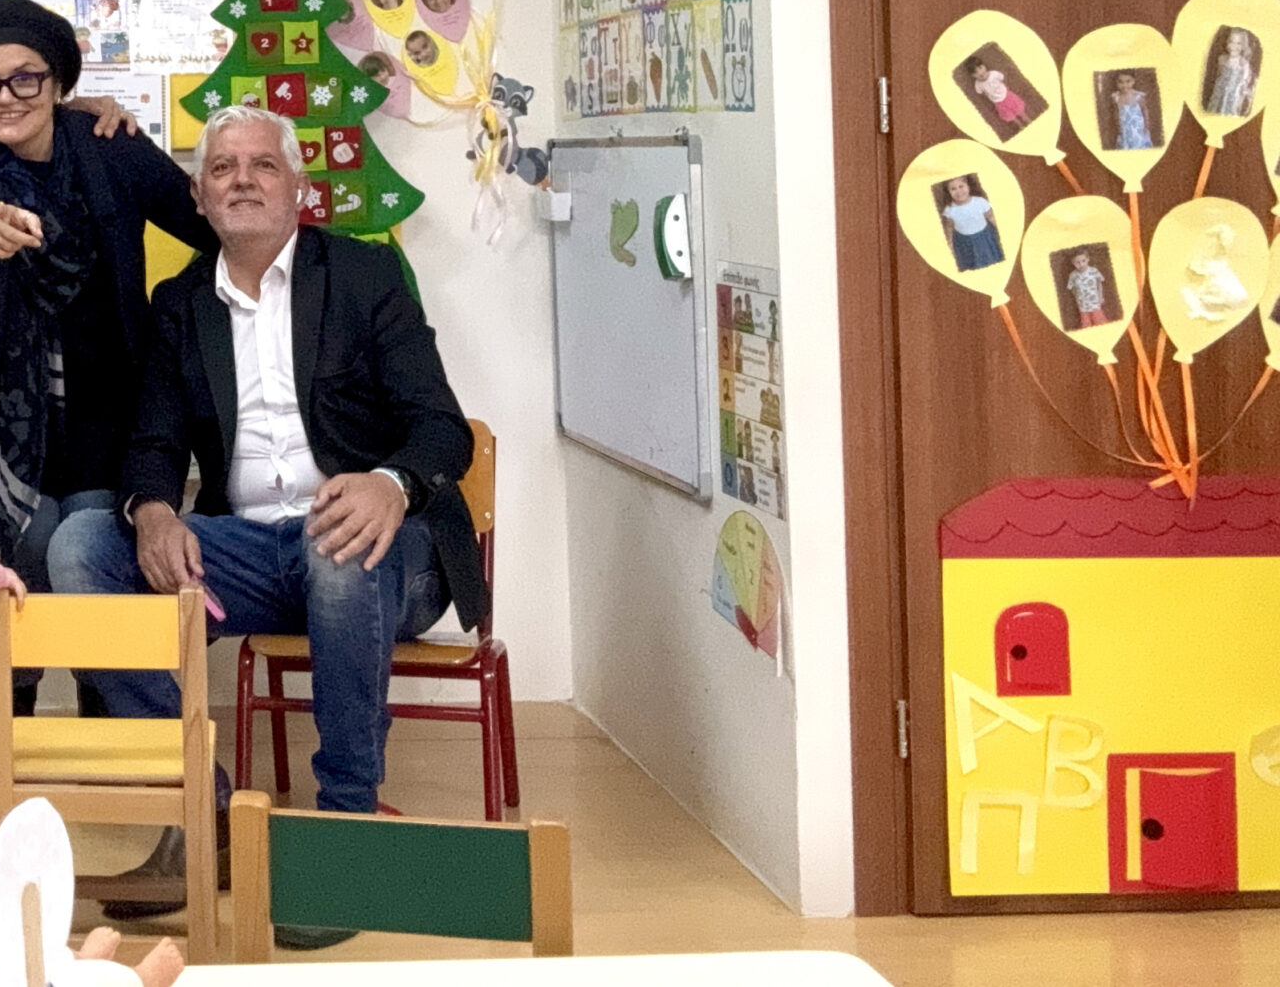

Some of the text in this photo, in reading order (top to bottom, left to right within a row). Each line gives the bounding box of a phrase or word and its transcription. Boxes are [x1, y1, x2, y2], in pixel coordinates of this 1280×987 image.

[261, 38, 270, 48] 2
[299, 38, 307, 48] 3
[329, 77, 337, 87] 6
[330, 131, 344, 141] 10
[305, 147, 314, 157] 9
[722, 335, 730, 361] 3
[952, 671, 1044, 775] Α
[1044, 713, 1105, 809] Β
[960, 789, 1039, 875] Π
